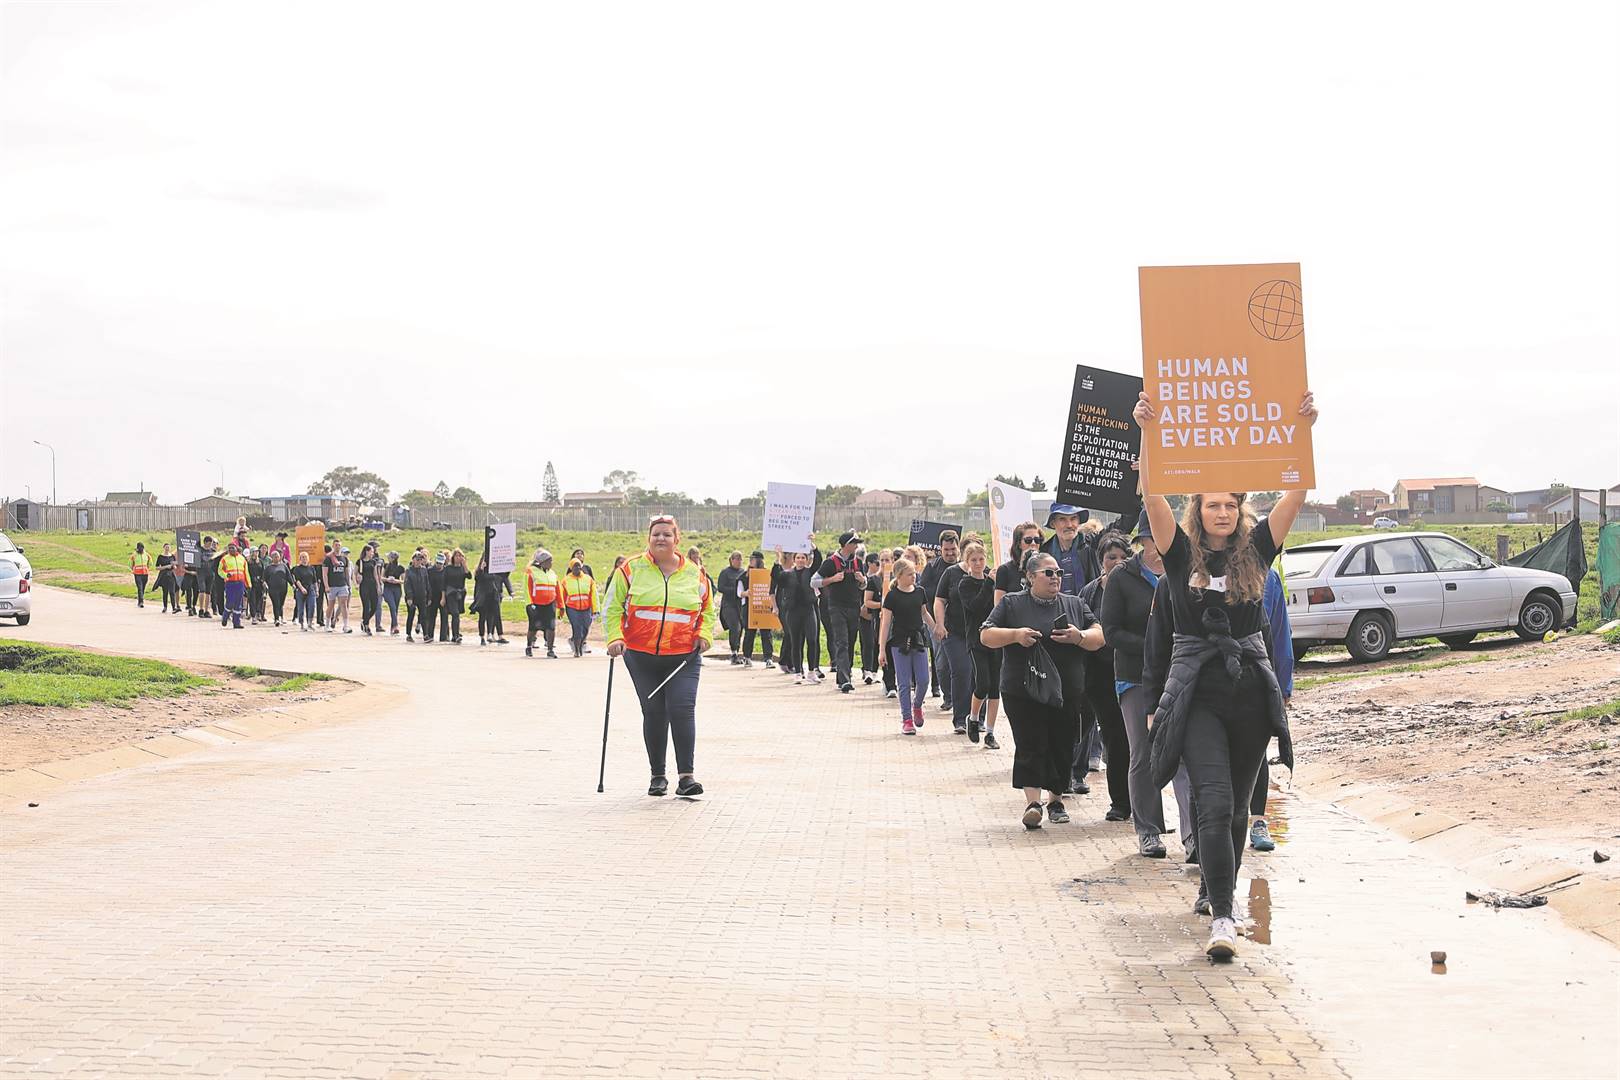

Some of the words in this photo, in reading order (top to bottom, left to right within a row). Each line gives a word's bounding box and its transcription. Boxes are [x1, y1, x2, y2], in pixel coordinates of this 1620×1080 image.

[1157, 357, 1248, 378] HUMAN
[1158, 380, 1252, 401] BEINGS
[1077, 403, 1107, 416] HUMAN
[1159, 404, 1209, 424] ARE
[1217, 402, 1282, 423] SOLD
[1074, 423, 1083, 432] IS
[1085, 425, 1101, 435] THE
[1076, 413, 1129, 430] TRAFFICKING
[1073, 433, 1129, 451] EXPLOITATION
[1161, 427, 1240, 448] EVERY
[1249, 424, 1296, 446] DAY
[1070, 453, 1101, 466] PEOPLE
[1103, 459, 1119, 469] FOR
[1071, 443, 1082, 452] OF
[1084, 445, 1136, 462] VULNERABLE
[1068, 463, 1092, 475] THEIR
[1094, 468, 1124, 480] BODIES
[1066, 473, 1084, 483] AND
[1086, 477, 1120, 490] LABOUR.
